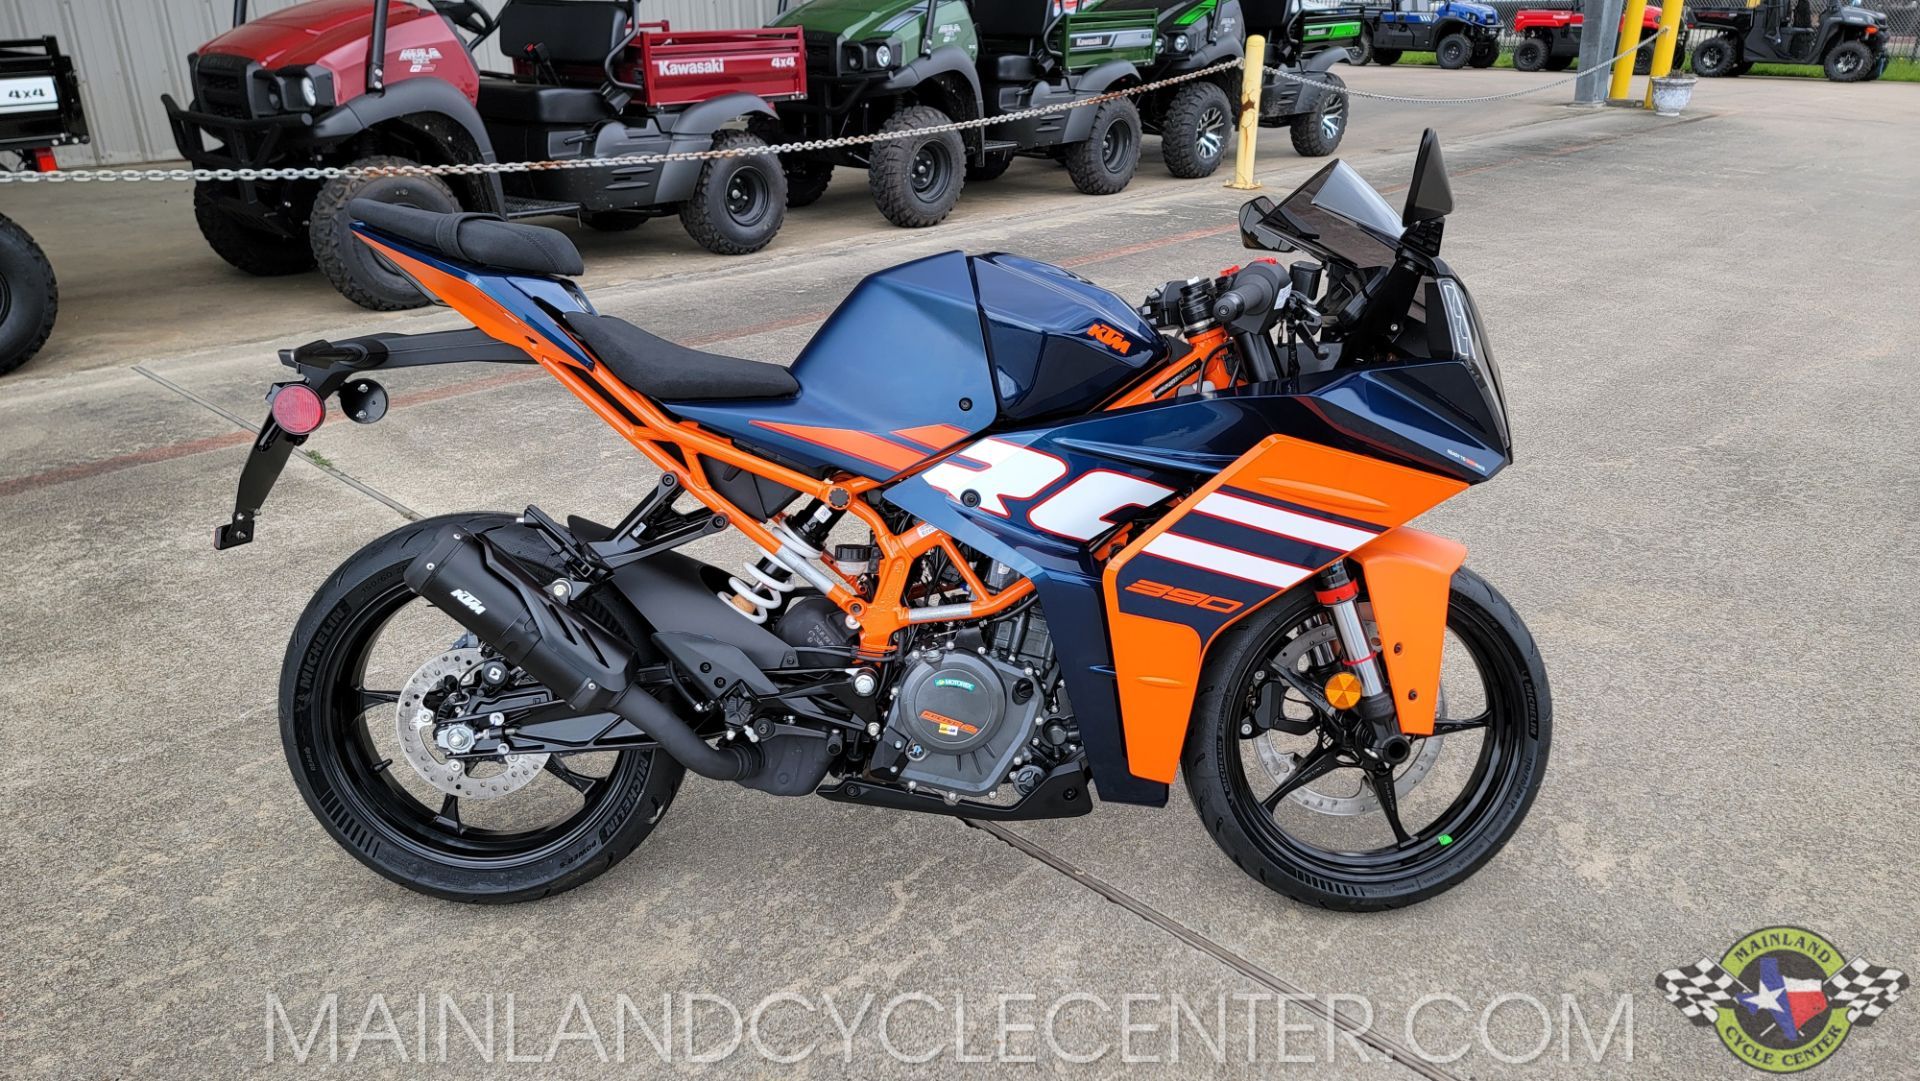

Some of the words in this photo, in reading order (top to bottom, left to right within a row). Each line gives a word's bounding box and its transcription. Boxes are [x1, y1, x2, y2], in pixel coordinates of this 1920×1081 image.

[659, 57, 725, 76] Kawasaki
[771, 56, 796, 68] 4x4
[8, 87, 46, 99] 4x4
[1087, 323, 1132, 354] KTM
[451, 589, 486, 615] KTM
[1124, 579, 1244, 614] 390
[300, 605, 348, 690] MICHELIN
[1525, 682, 1538, 737] MICHELIN
[1217, 741, 1231, 793] MICHELIN
[604, 759, 649, 837] MICHELIN
